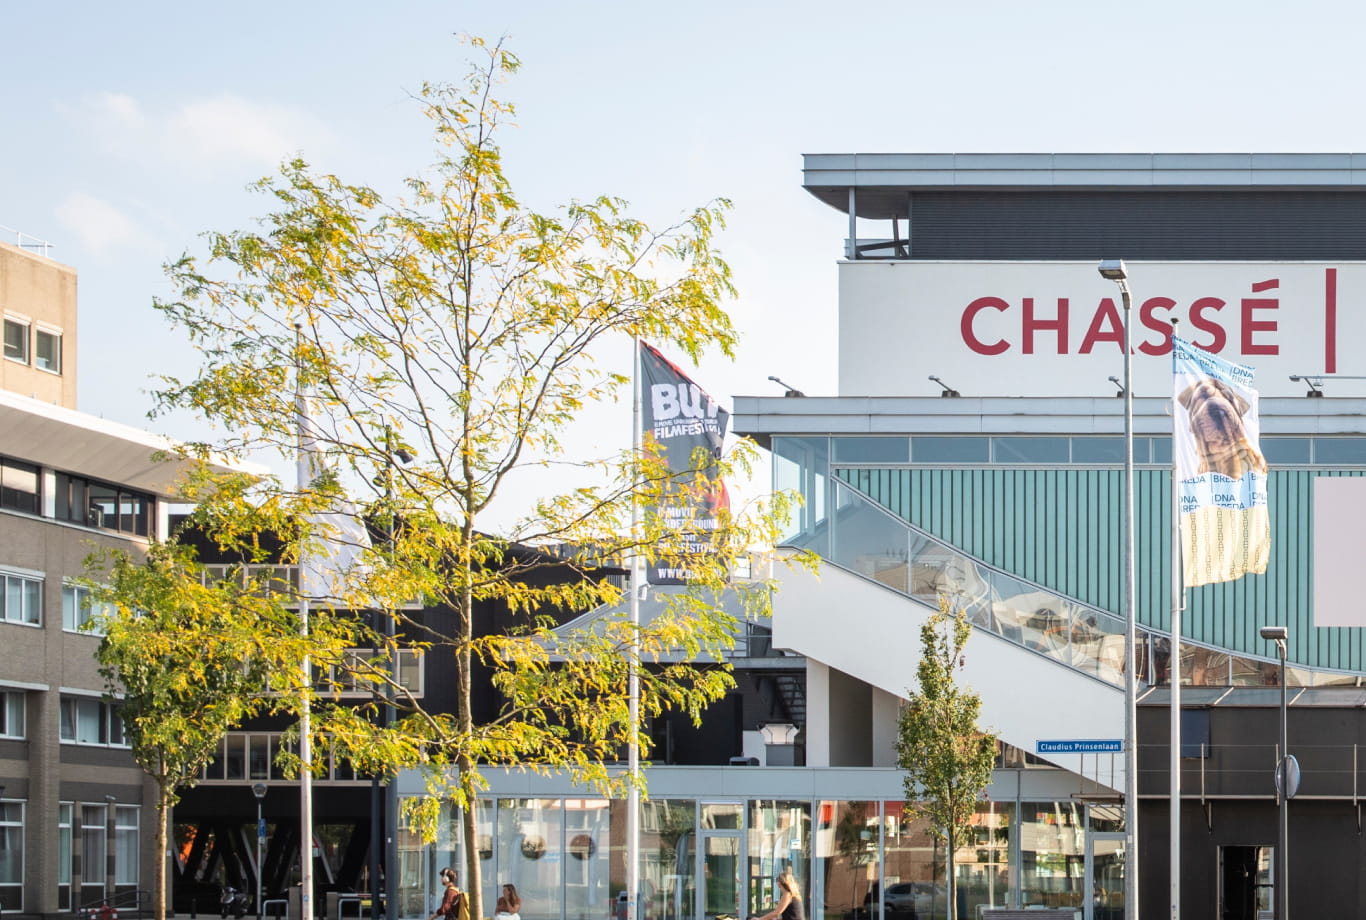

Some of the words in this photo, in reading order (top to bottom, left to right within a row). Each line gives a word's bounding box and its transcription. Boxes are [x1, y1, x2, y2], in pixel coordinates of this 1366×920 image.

[960, 279, 1280, 356] CHASSÉ
[1214, 494, 1235, 502] DNA
[1040, 743, 1073, 751] Claudius
